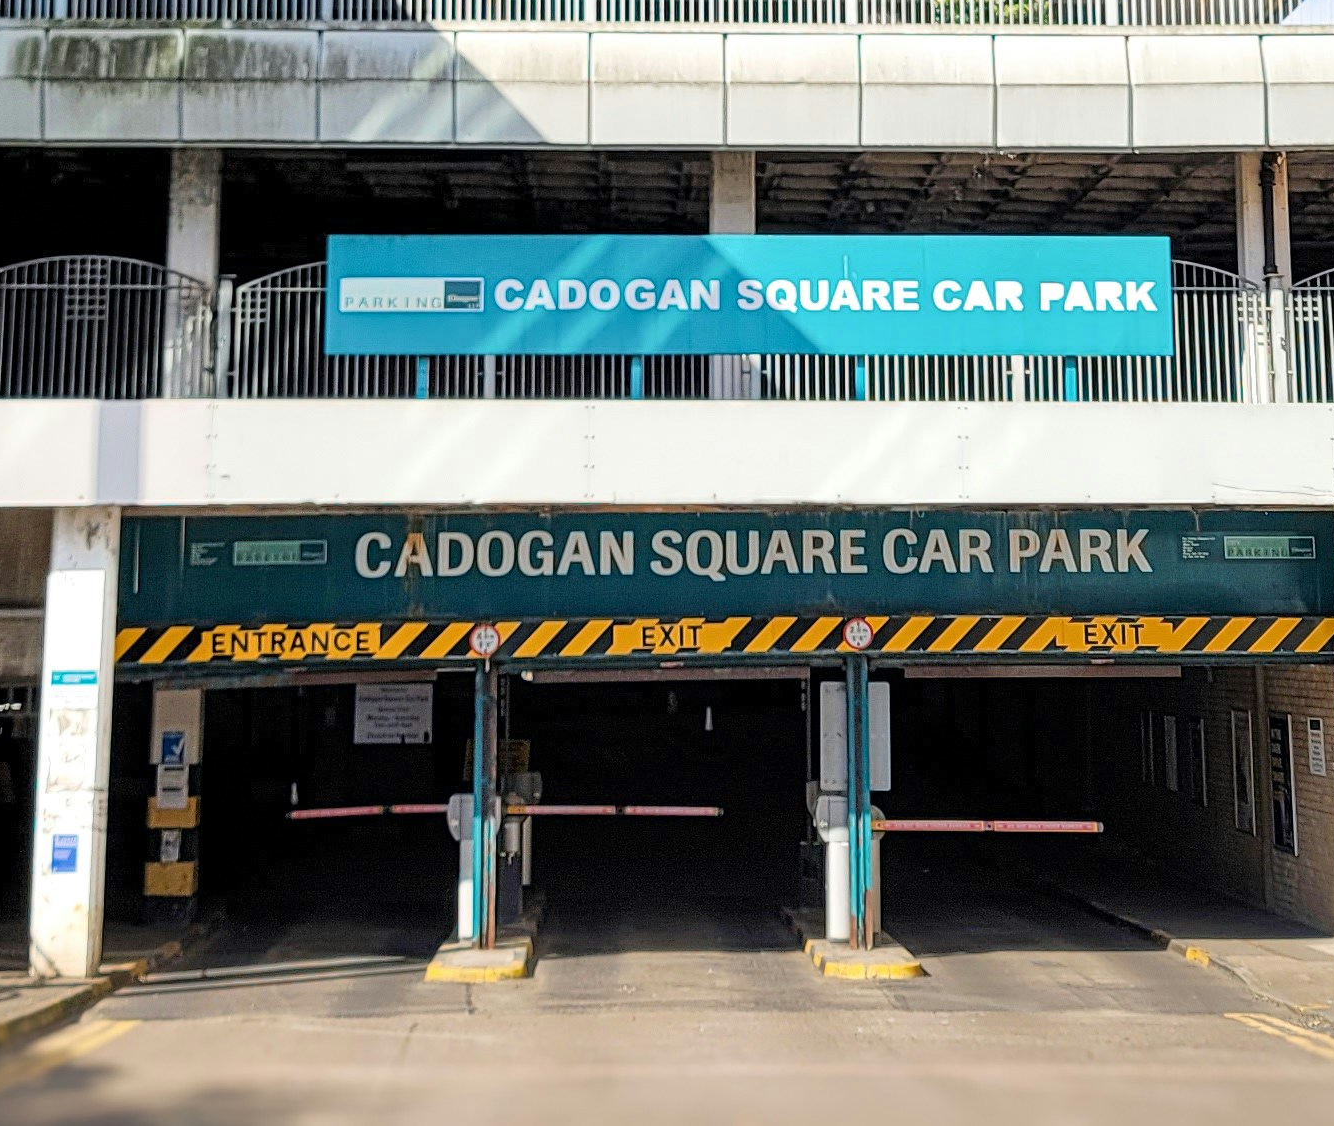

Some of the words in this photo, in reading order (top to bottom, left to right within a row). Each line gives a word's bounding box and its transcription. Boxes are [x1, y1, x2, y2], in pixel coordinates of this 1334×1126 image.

[344, 296, 443, 309] PARKING
[494, 278, 721, 311] CADOGAN
[737, 279, 920, 313] SQUARE
[933, 280, 1025, 312] CAR
[1040, 280, 1159, 312] PARK
[354, 530, 635, 578] CADOGAN
[649, 529, 868, 582] SQUARE
[881, 528, 993, 574] CAR
[1008, 528, 1154, 574] PARK
[211, 630, 370, 653] ENTRANCE
[642, 625, 703, 647] EXIT
[1083, 623, 1145, 646] EXIT
